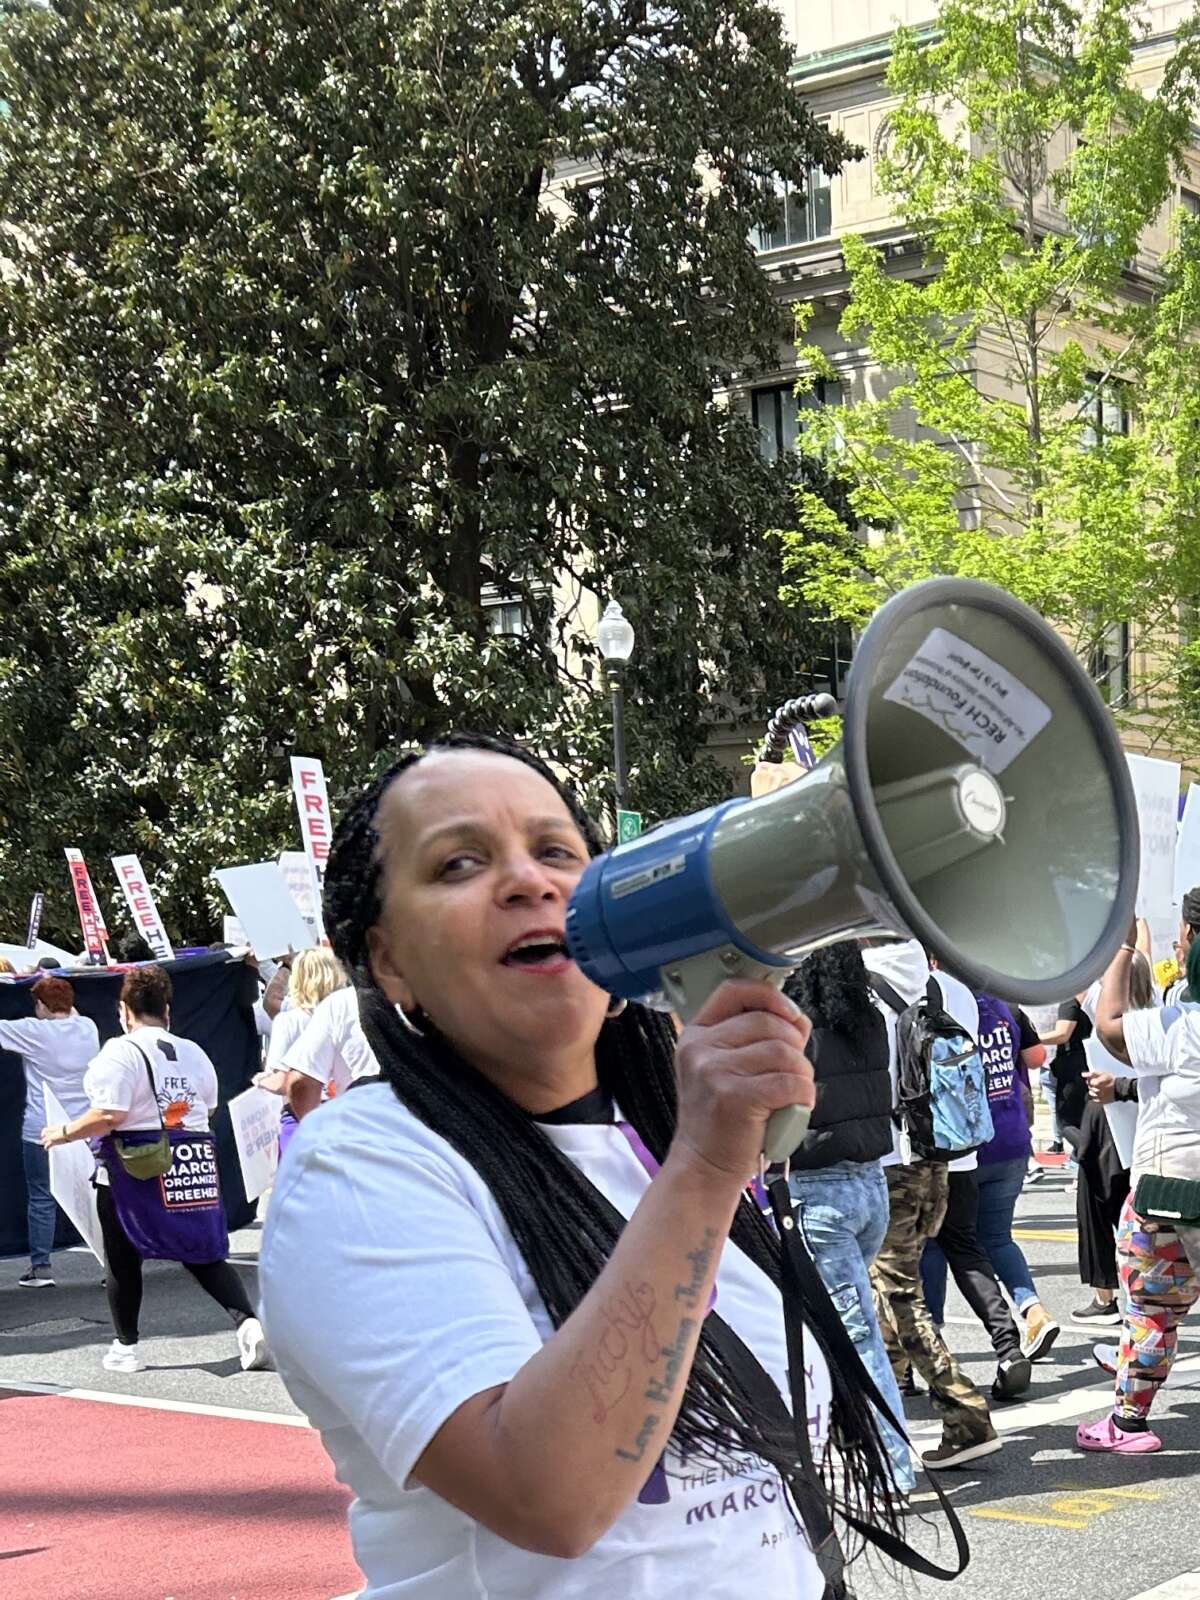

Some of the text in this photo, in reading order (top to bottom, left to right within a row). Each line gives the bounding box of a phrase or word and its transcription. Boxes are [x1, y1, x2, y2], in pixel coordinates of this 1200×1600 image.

[963, 703, 1007, 744] RECH
[121, 865, 169, 960] FREEHE
[164, 1174, 217, 1188] ORGANIZE
[166, 1188, 218, 1201] FREEHER
[680, 1468, 717, 1492] THE
[685, 1478, 777, 1526] MARC
